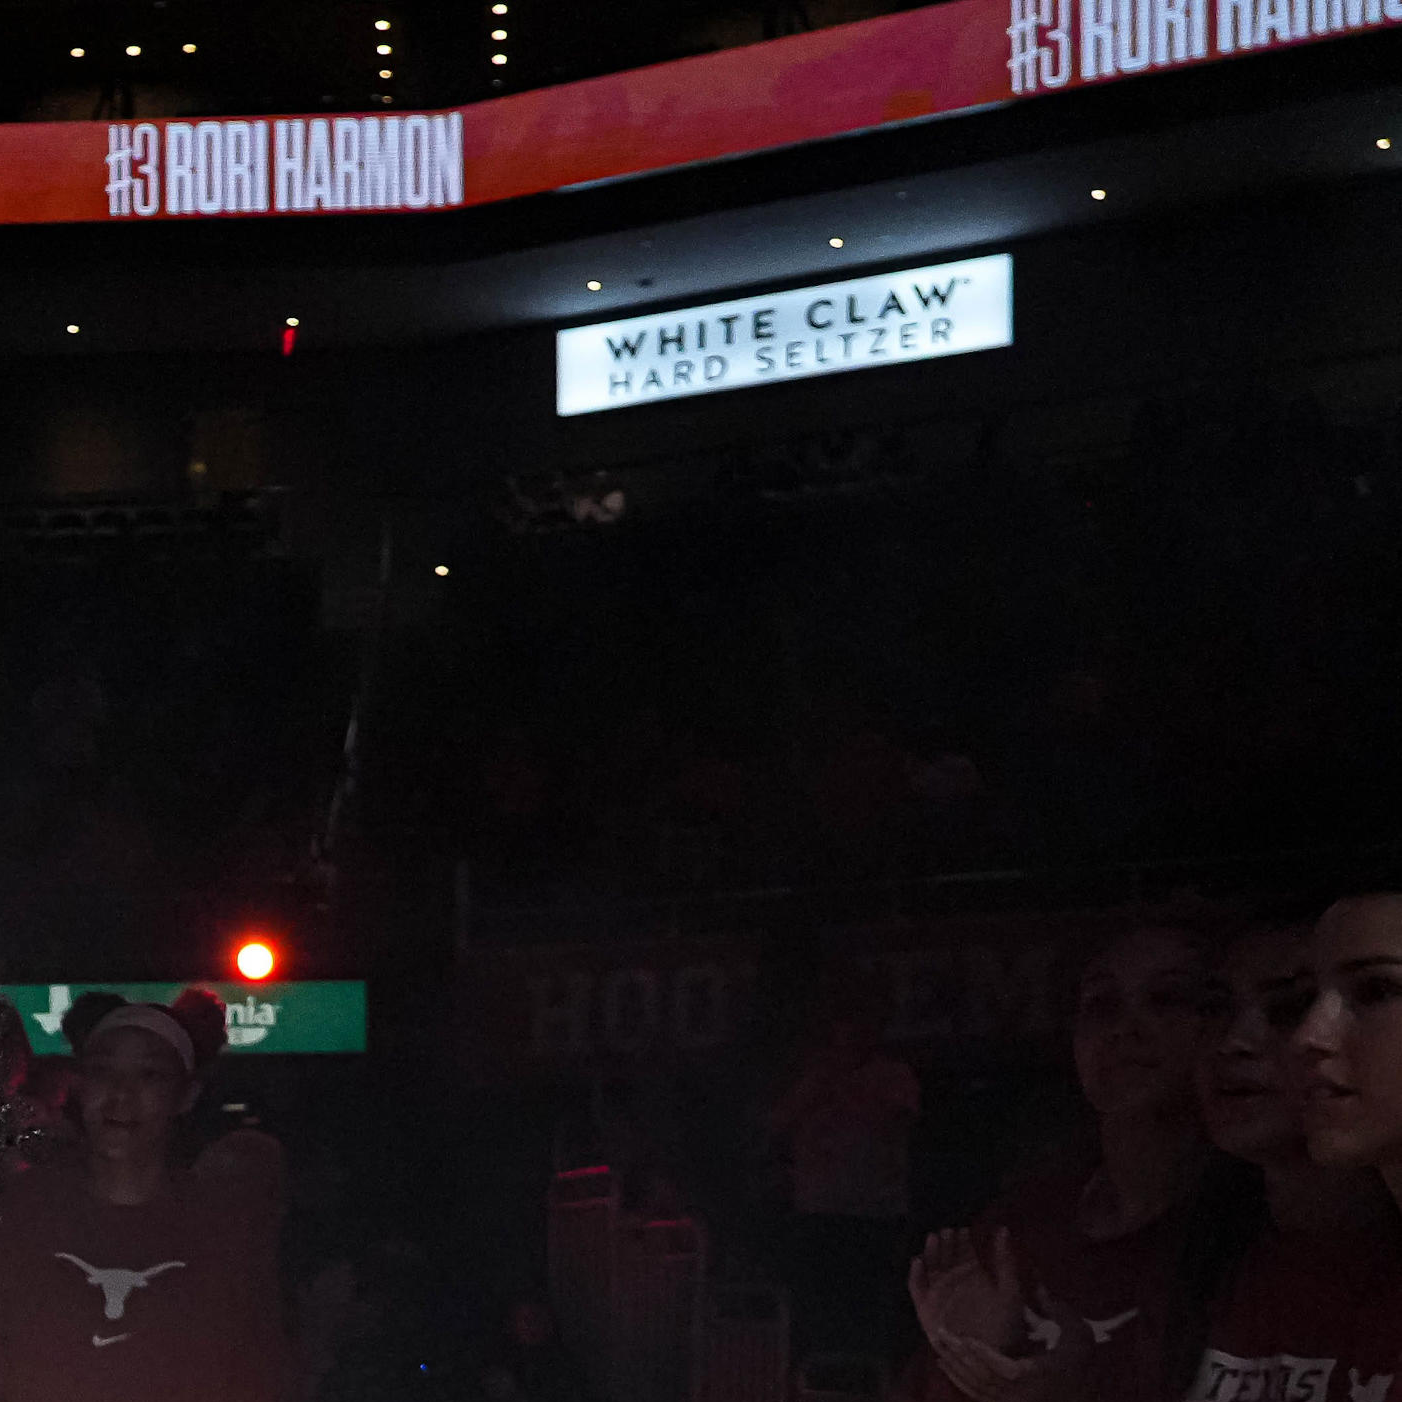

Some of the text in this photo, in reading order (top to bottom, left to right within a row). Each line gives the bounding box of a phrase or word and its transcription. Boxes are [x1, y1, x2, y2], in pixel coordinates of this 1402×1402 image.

[1006, 0, 1072, 94] #3
[105, 111, 465, 217] #3 RORI HARMON
[605, 277, 962, 361] WHITE CLAW
[608, 316, 956, 398] HARD SELTZER
